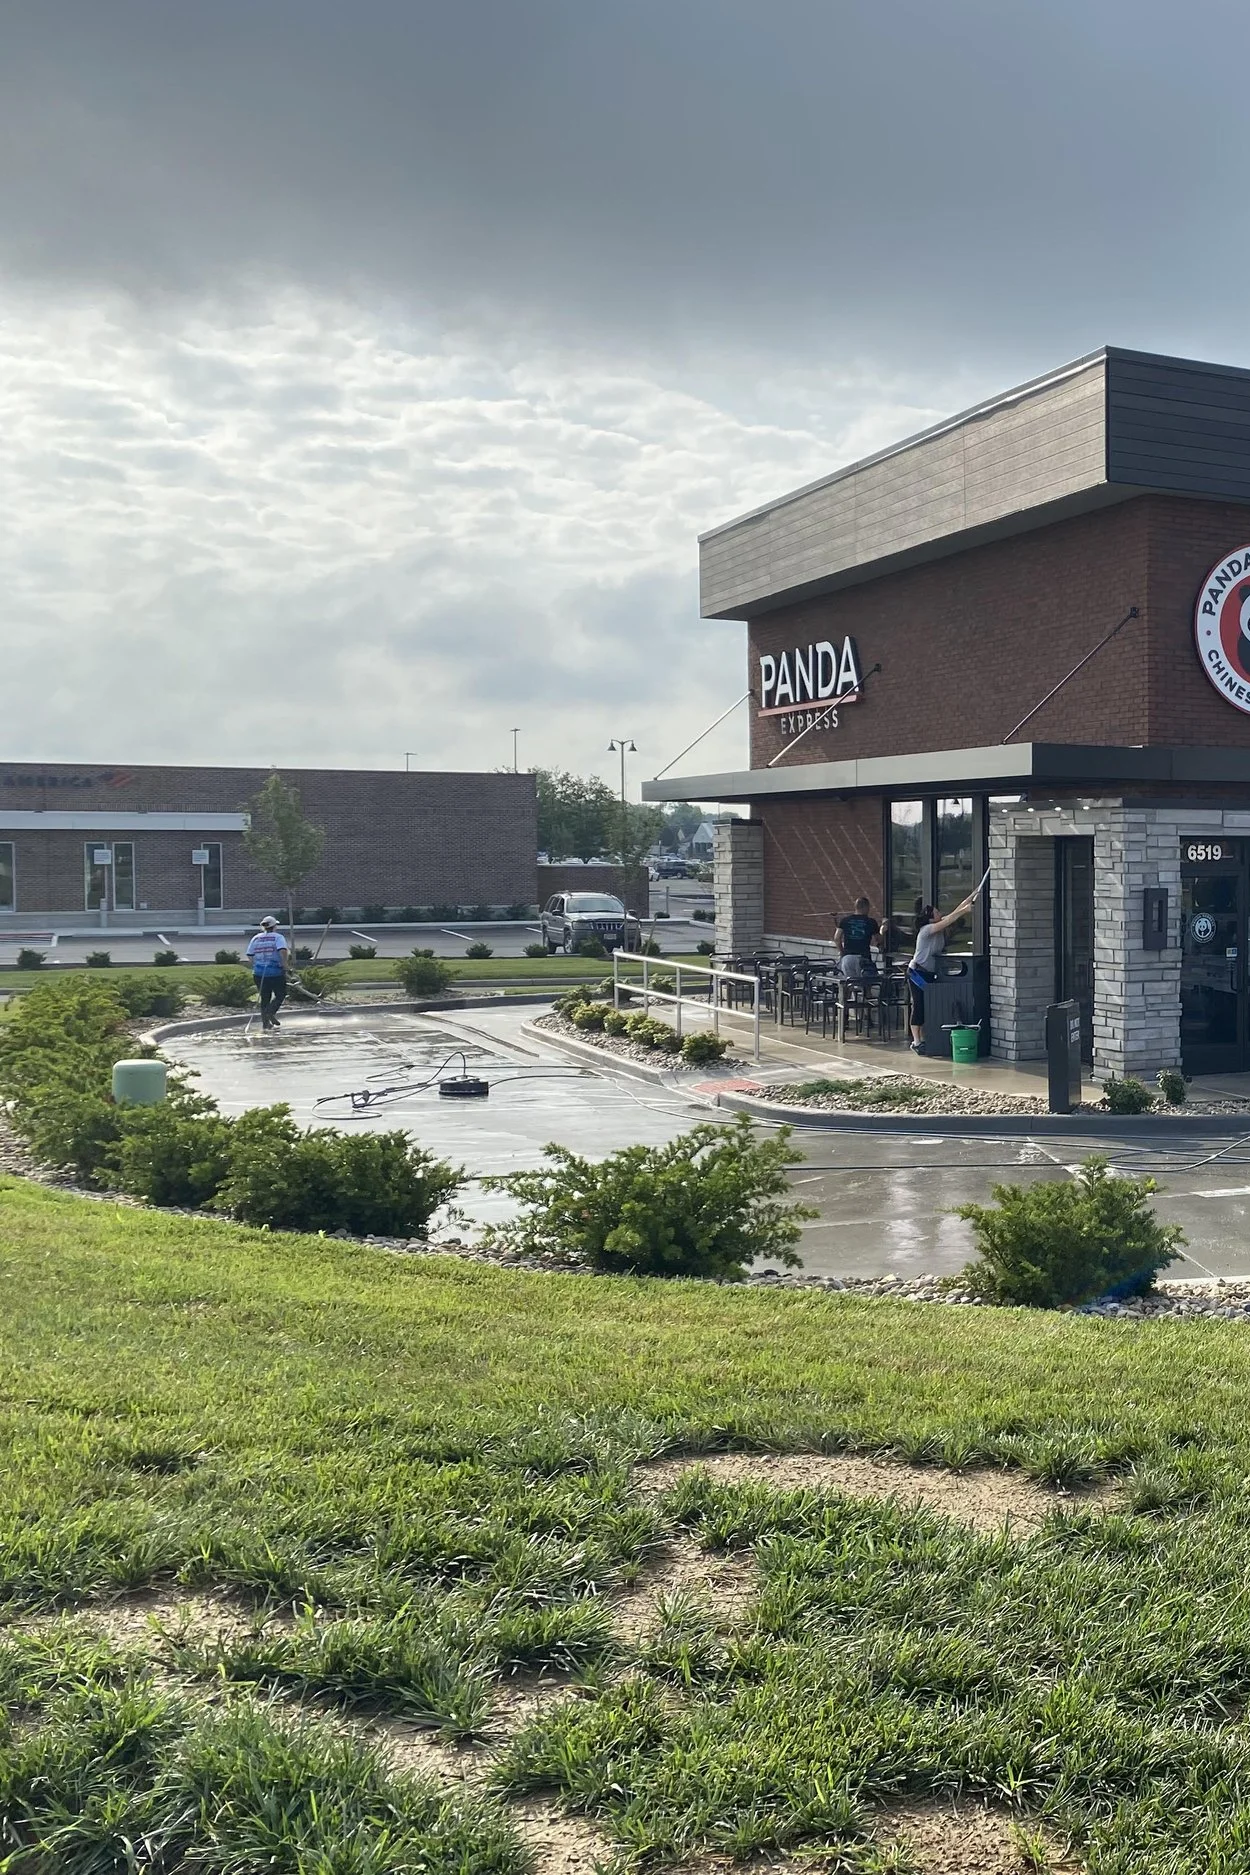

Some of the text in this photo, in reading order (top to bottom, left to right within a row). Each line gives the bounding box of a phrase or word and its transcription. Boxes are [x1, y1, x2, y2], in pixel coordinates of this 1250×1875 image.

[760, 635, 859, 708] PANDA
[781, 710, 839, 734] EXPRESS
[1187, 845, 1222, 861] 6519
